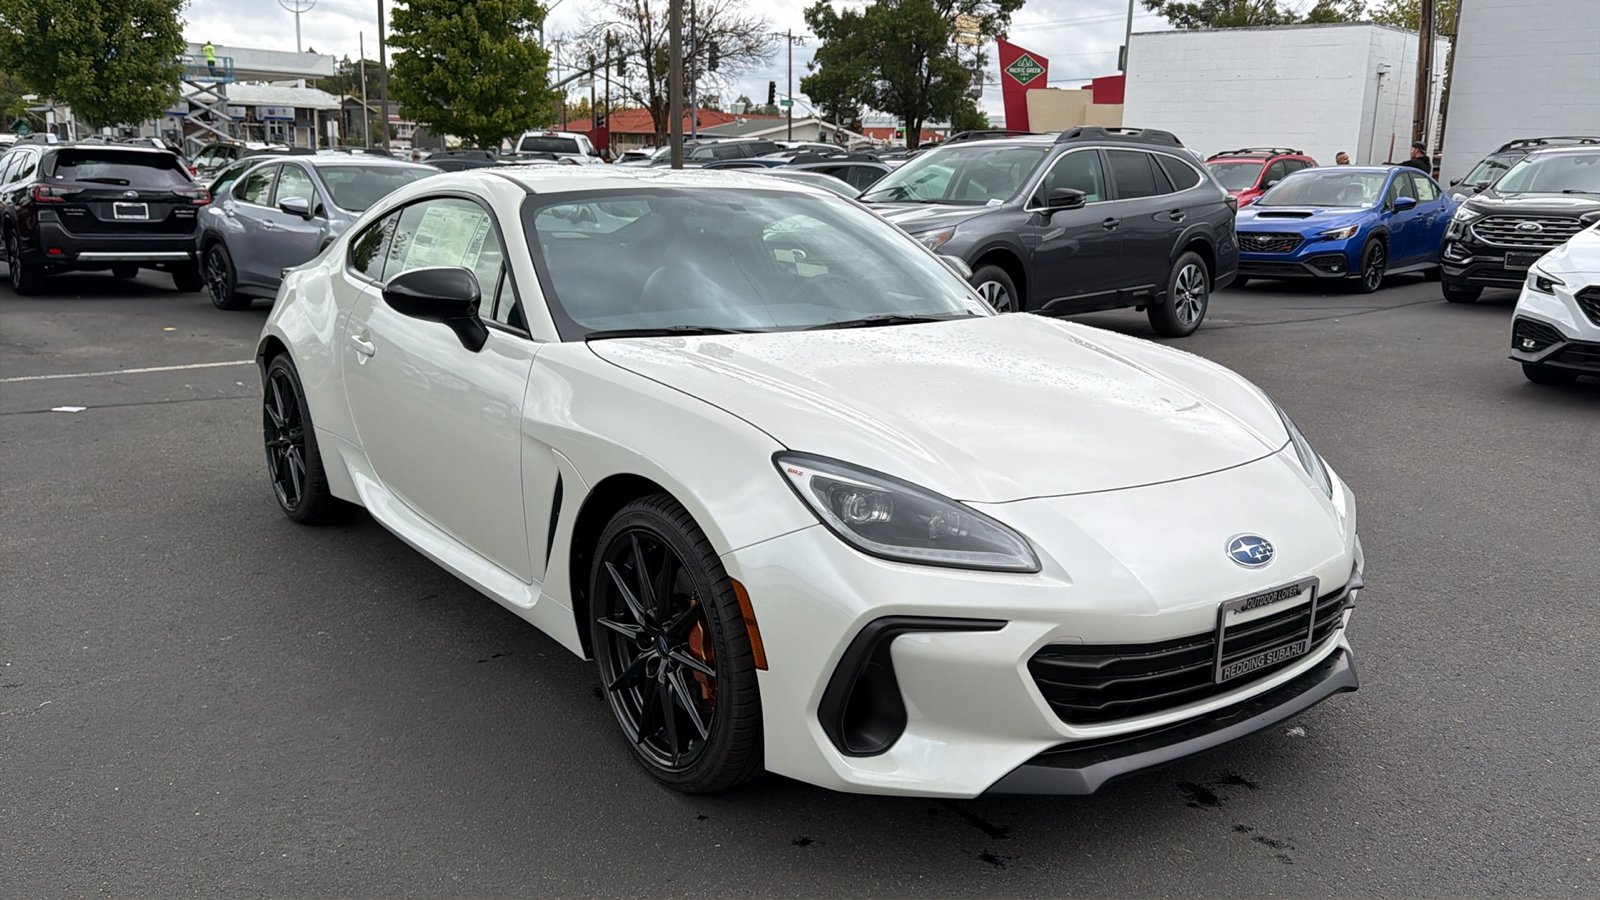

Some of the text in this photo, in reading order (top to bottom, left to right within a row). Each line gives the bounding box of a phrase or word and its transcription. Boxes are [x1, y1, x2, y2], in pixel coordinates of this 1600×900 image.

[1246, 586, 1298, 609] OUTDOOR LOVER
[1223, 642, 1305, 680] REDDING SUBARU
